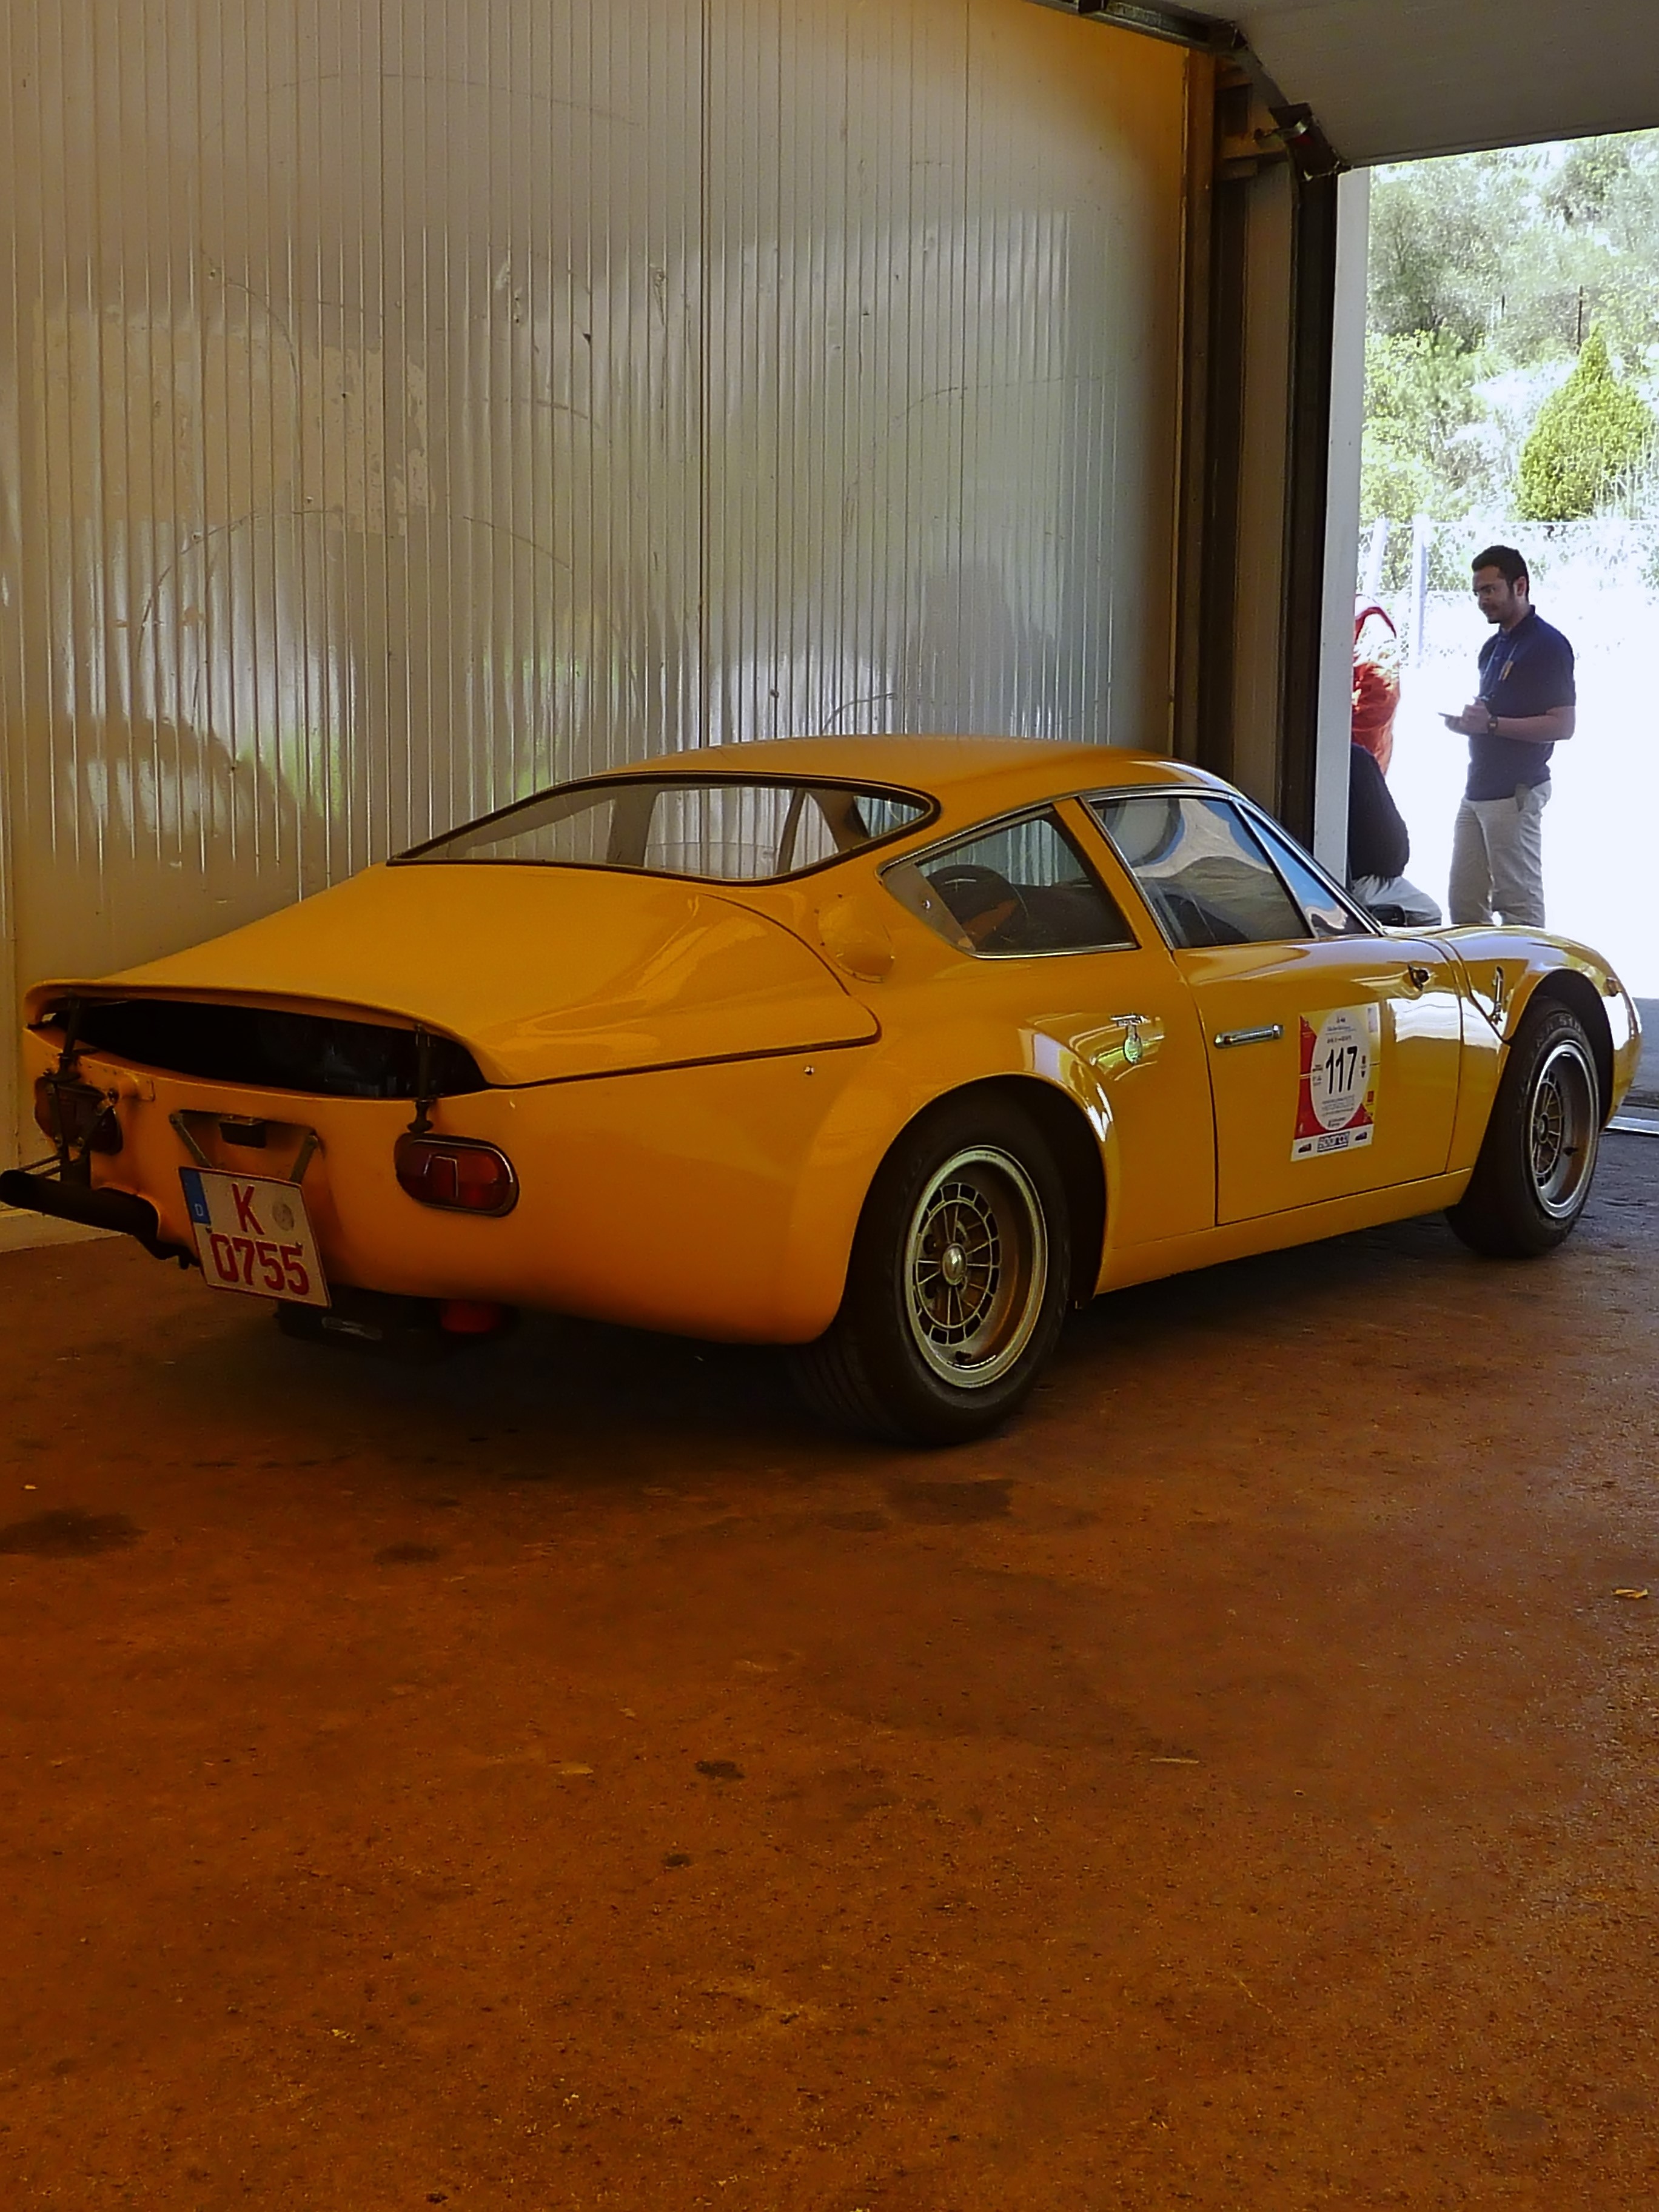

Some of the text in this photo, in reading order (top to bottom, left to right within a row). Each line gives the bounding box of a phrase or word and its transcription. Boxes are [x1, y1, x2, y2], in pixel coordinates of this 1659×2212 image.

[1326, 1045, 1358, 1094] 117
[194, 1203, 204, 1216] D
[232, 1182, 265, 1235] K
[210, 1233, 310, 1295] 0755
